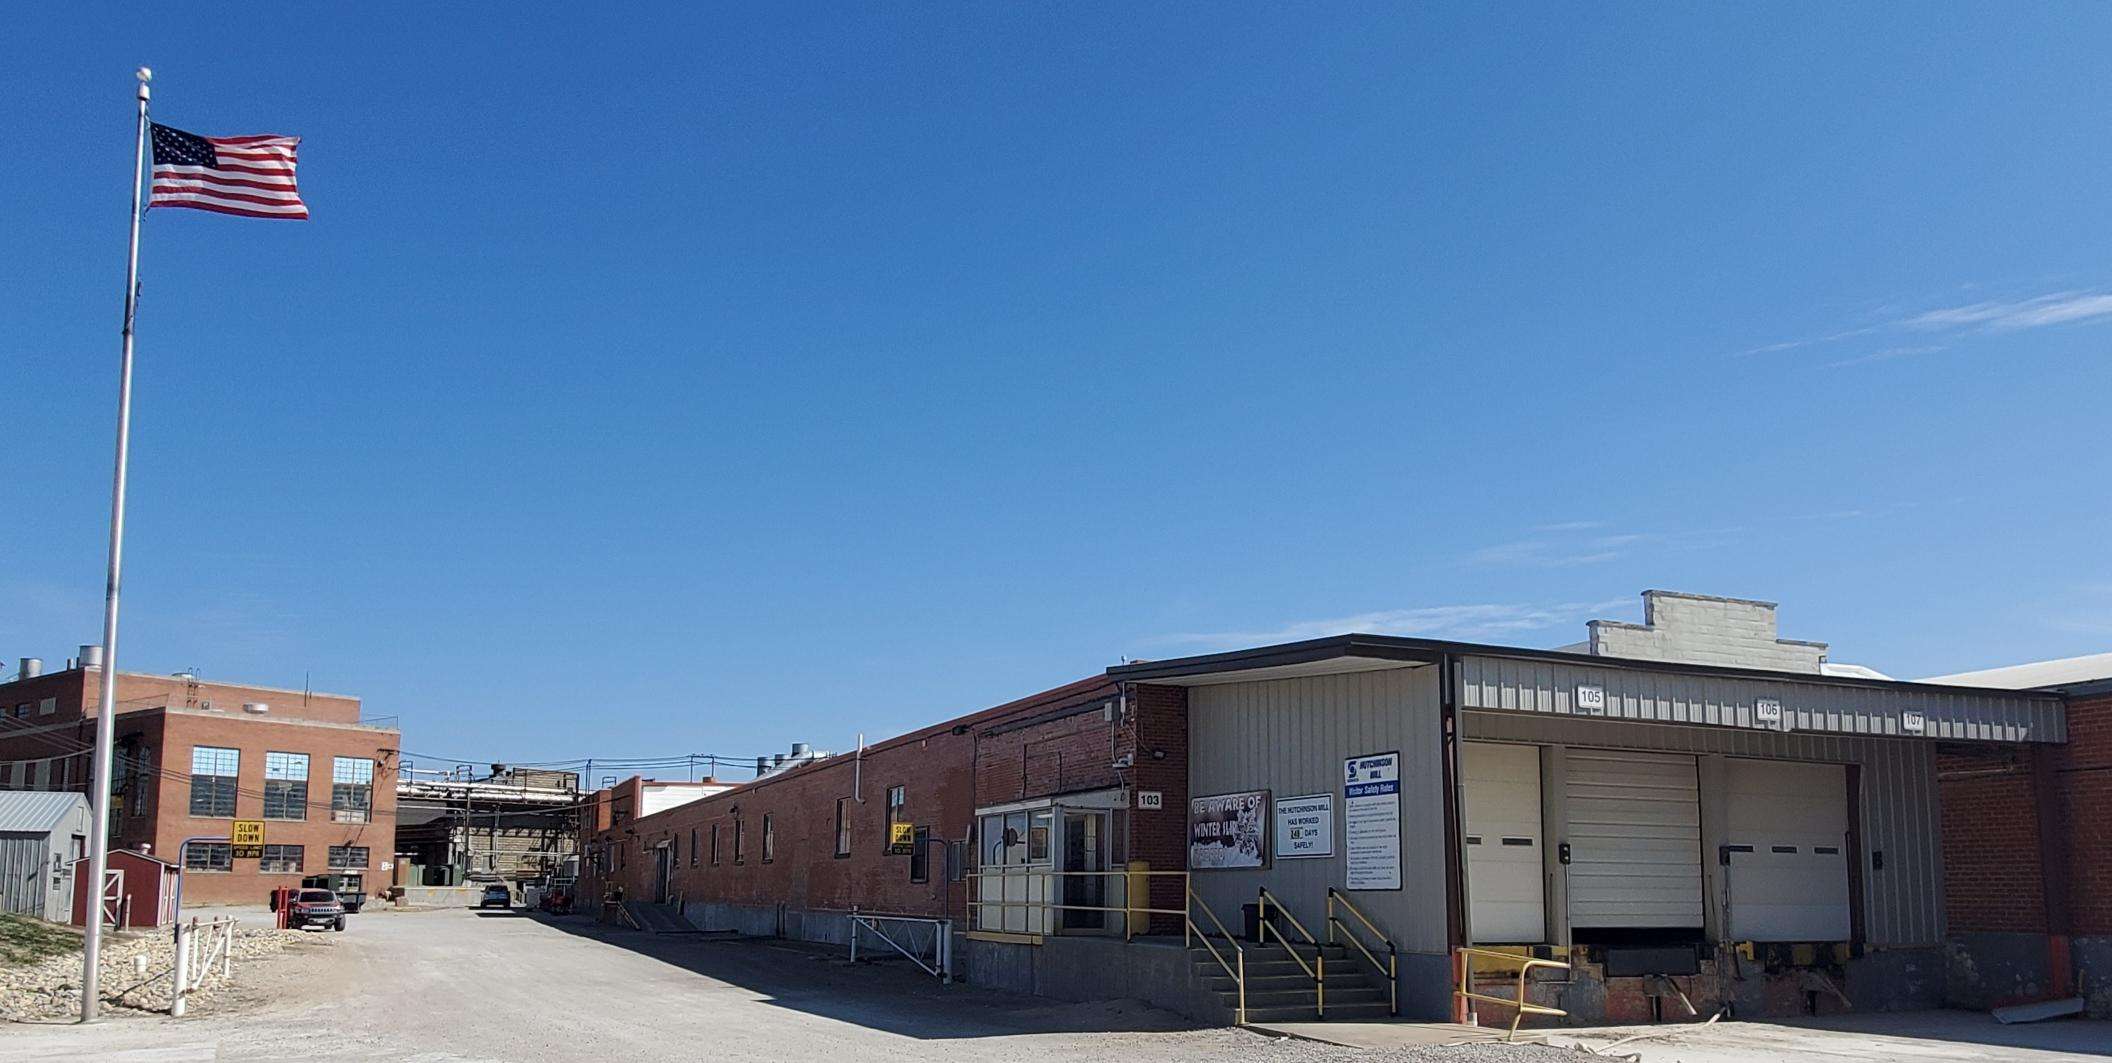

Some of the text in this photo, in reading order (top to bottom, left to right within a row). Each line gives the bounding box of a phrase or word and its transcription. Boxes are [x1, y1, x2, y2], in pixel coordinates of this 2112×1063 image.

[1582, 690, 1601, 703] 105
[1760, 703, 1778, 715] 106
[1907, 714, 1921, 725] 107
[1359, 757, 1393, 769] HUTCHINSON
[1364, 785, 1379, 795] Safety
[1380, 783, 1394, 792] Rules
[1140, 795, 1160, 805] 103
[1193, 795, 1262, 814] BE AWARE OF
[1287, 805, 1317, 814] HUTCHINSON
[1298, 816, 1320, 825] WORKED
[238, 824, 260, 832] SLOW
[1193, 821, 1221, 838] WINTER
[1304, 829, 1318, 837] DAYS
[237, 834, 260, 842] DOWN
